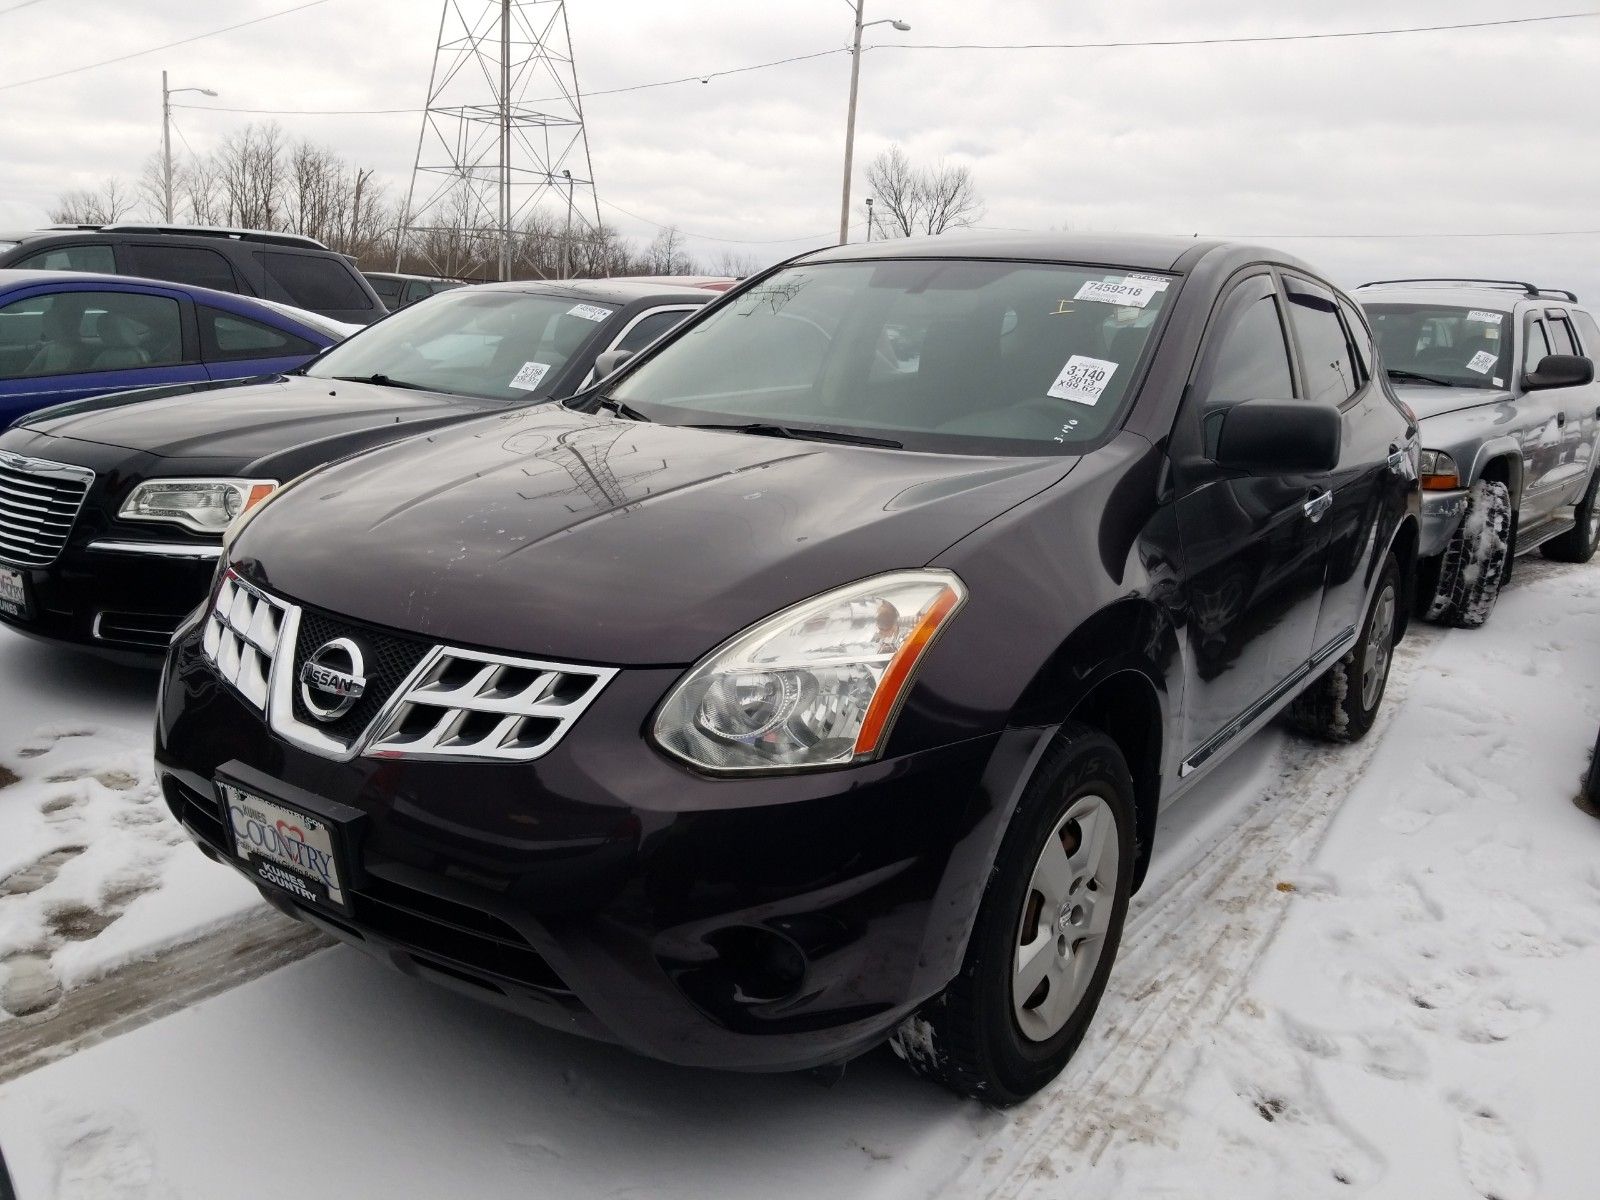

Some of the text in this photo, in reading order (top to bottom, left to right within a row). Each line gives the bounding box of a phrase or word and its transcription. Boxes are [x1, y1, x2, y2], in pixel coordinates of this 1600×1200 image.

[1088, 283, 1143, 296] 7459218
[1069, 375, 1096, 386] 2013
[303, 663, 354, 692] NISSAN
[230, 805, 339, 890] COUNTRY
[258, 868, 317, 901] COUNTRY
[262, 862, 306, 889] KUNES
